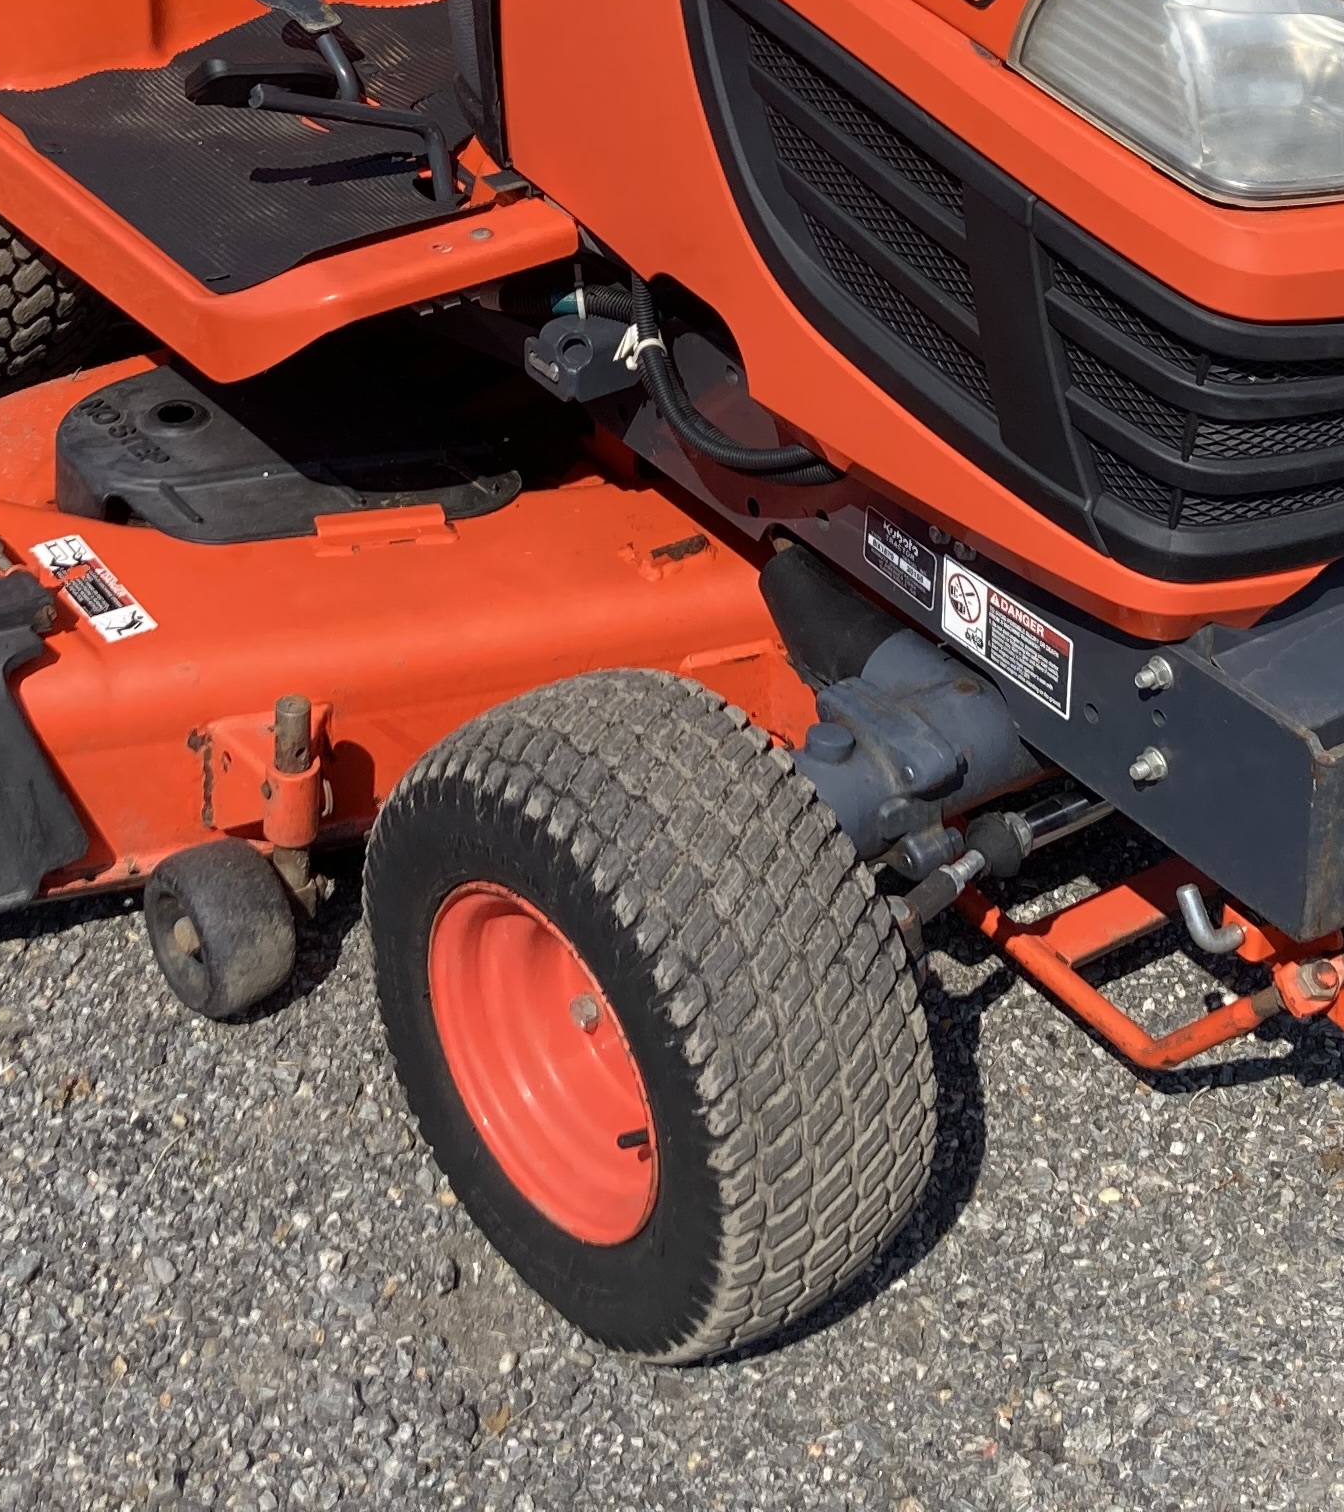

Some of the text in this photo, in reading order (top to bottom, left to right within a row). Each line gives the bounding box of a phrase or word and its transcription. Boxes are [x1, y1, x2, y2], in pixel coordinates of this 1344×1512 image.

[77, 397, 172, 464] NO STEP
[882, 519, 919, 557] Kubota
[1000, 599, 1046, 639] DANGER
